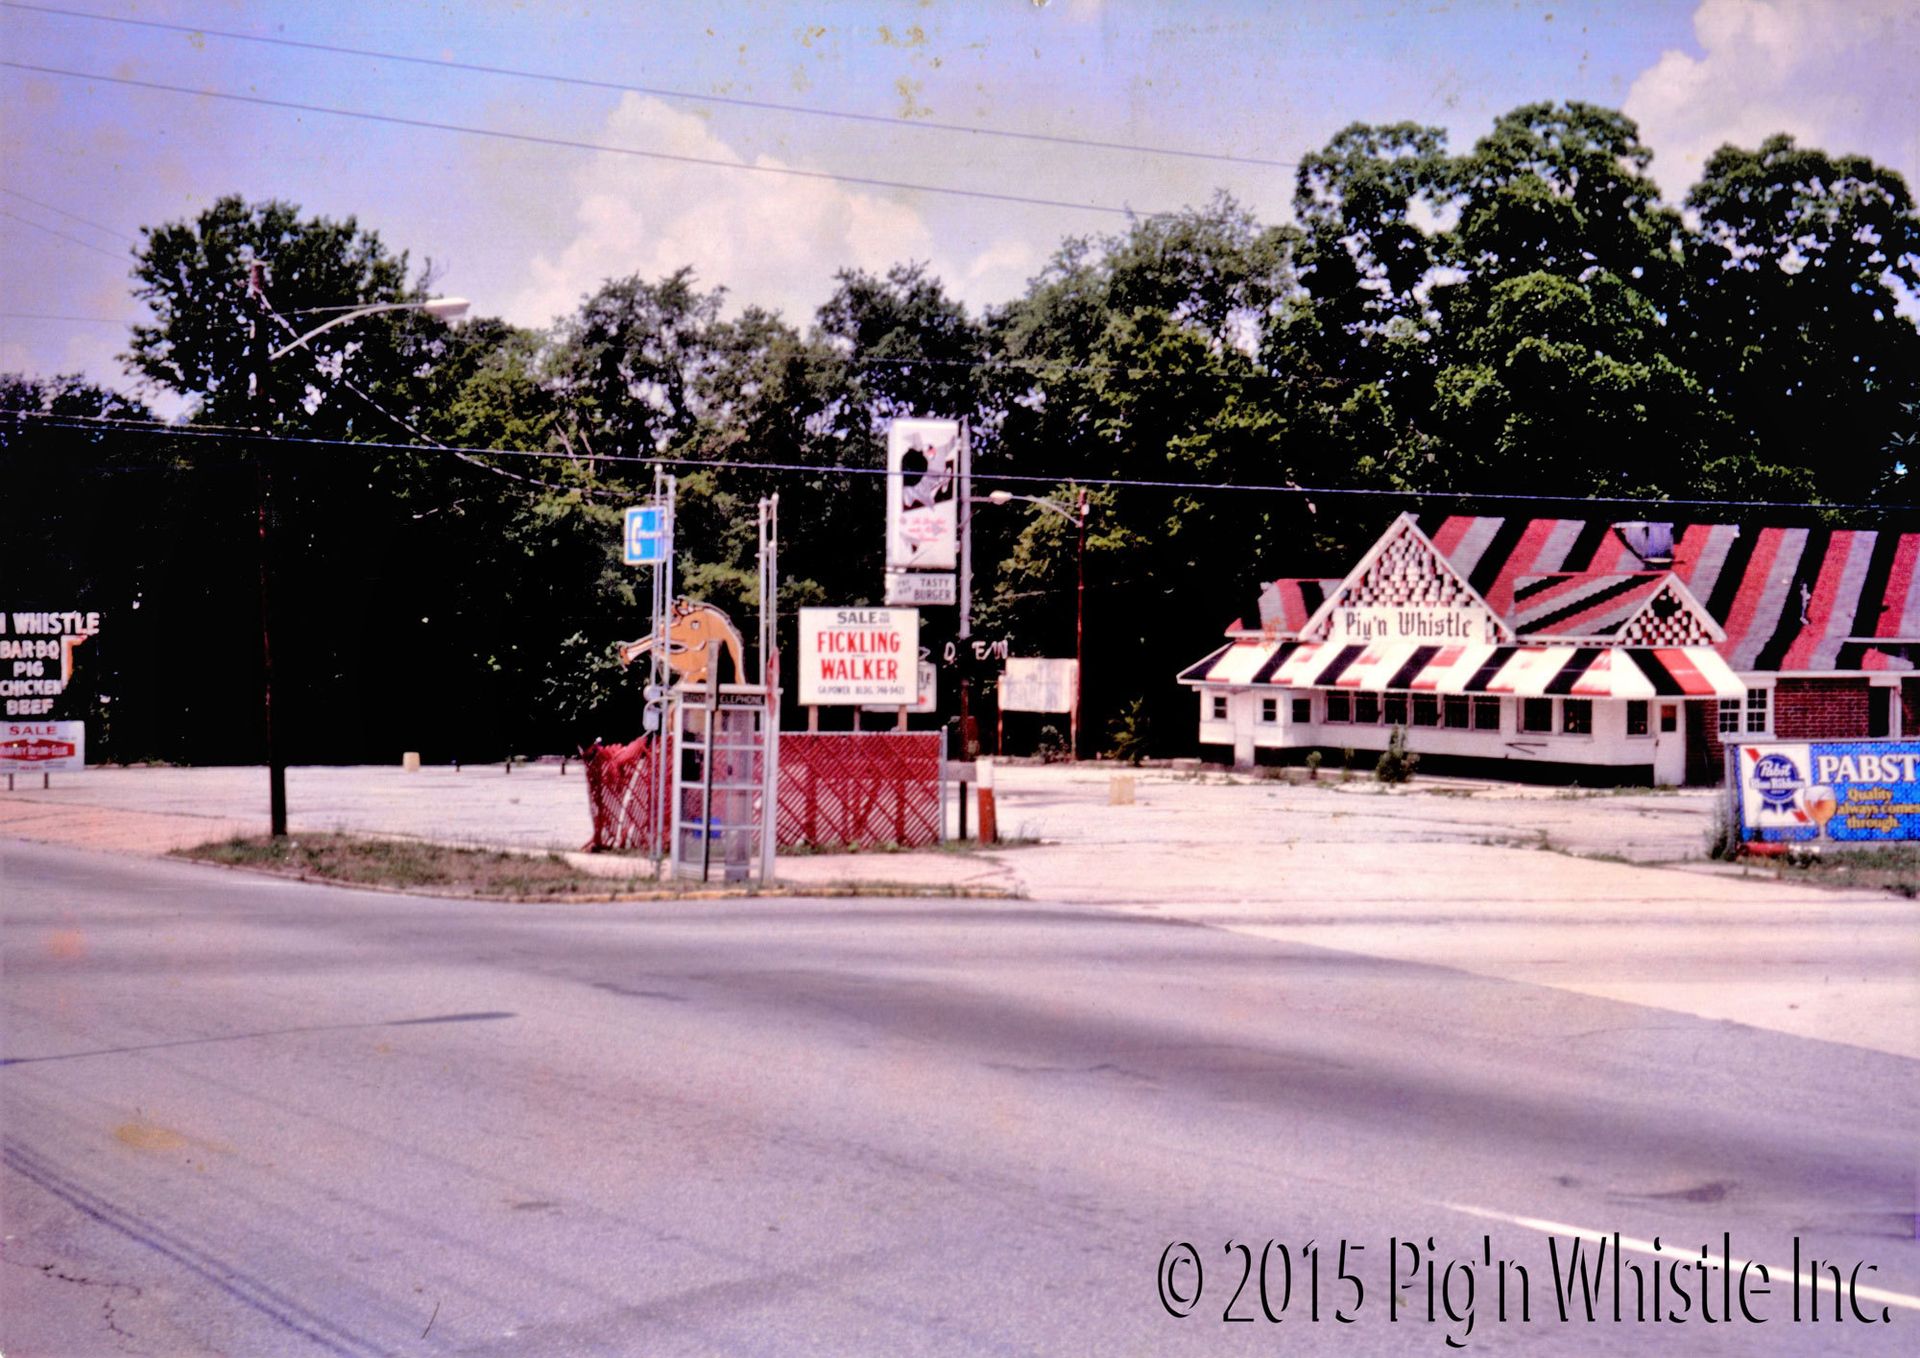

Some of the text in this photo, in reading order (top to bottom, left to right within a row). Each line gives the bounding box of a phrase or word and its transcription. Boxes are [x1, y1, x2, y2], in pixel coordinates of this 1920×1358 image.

[921, 578, 950, 587] TASTY
[914, 589, 951, 600] BURGER
[12, 611, 100, 636] WHISTLE
[837, 611, 878, 625] SALE
[1346, 611, 1473, 640] Pig'n Whistle
[817, 631, 901, 653] FICKLING
[13, 660, 44, 677] PIG
[820, 658, 899, 681] WALKER
[0, 680, 63, 697] CHICKEN
[6, 699, 54, 715] BEEF
[9, 725, 57, 736] SALE
[1760, 760, 1792, 778] Pabst
[1817, 753, 1920, 784] PABST
[1847, 787, 1893, 804] Quality
[1838, 801, 1879, 818] always
